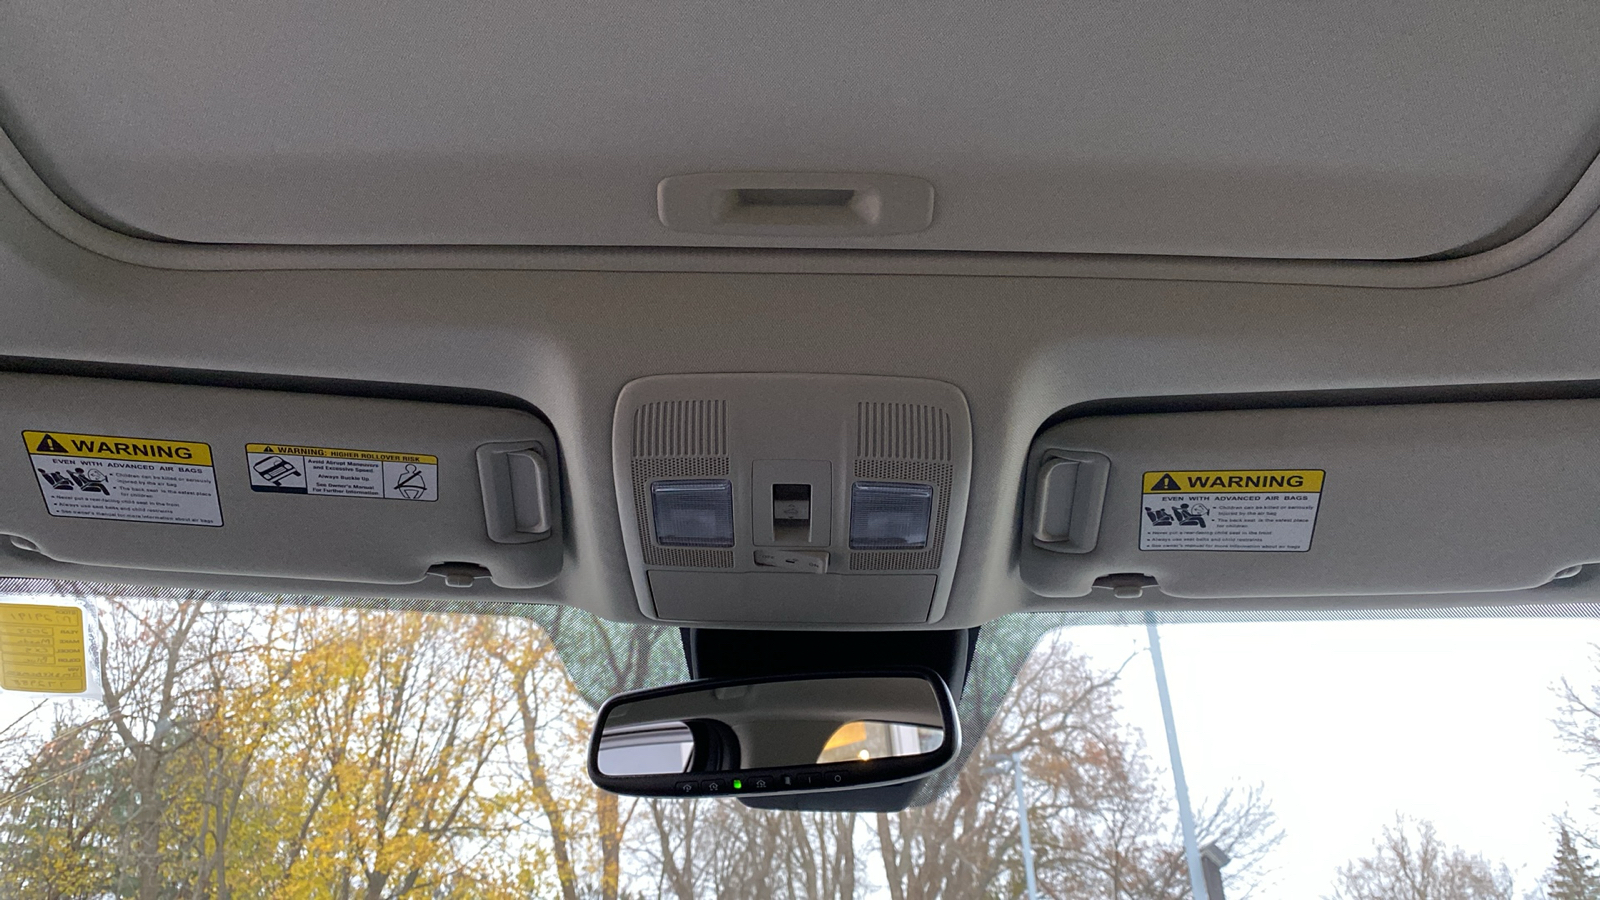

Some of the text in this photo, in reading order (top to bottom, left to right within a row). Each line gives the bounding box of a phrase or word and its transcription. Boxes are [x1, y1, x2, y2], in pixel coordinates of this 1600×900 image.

[71, 439, 193, 460] WARNING
[277, 446, 327, 456] WARNING:
[330, 451, 359, 459] HIGHER
[361, 453, 400, 461] ROLLOVER
[107, 462, 155, 470] ADVANCED
[1187, 475, 1304, 488] WARNING
